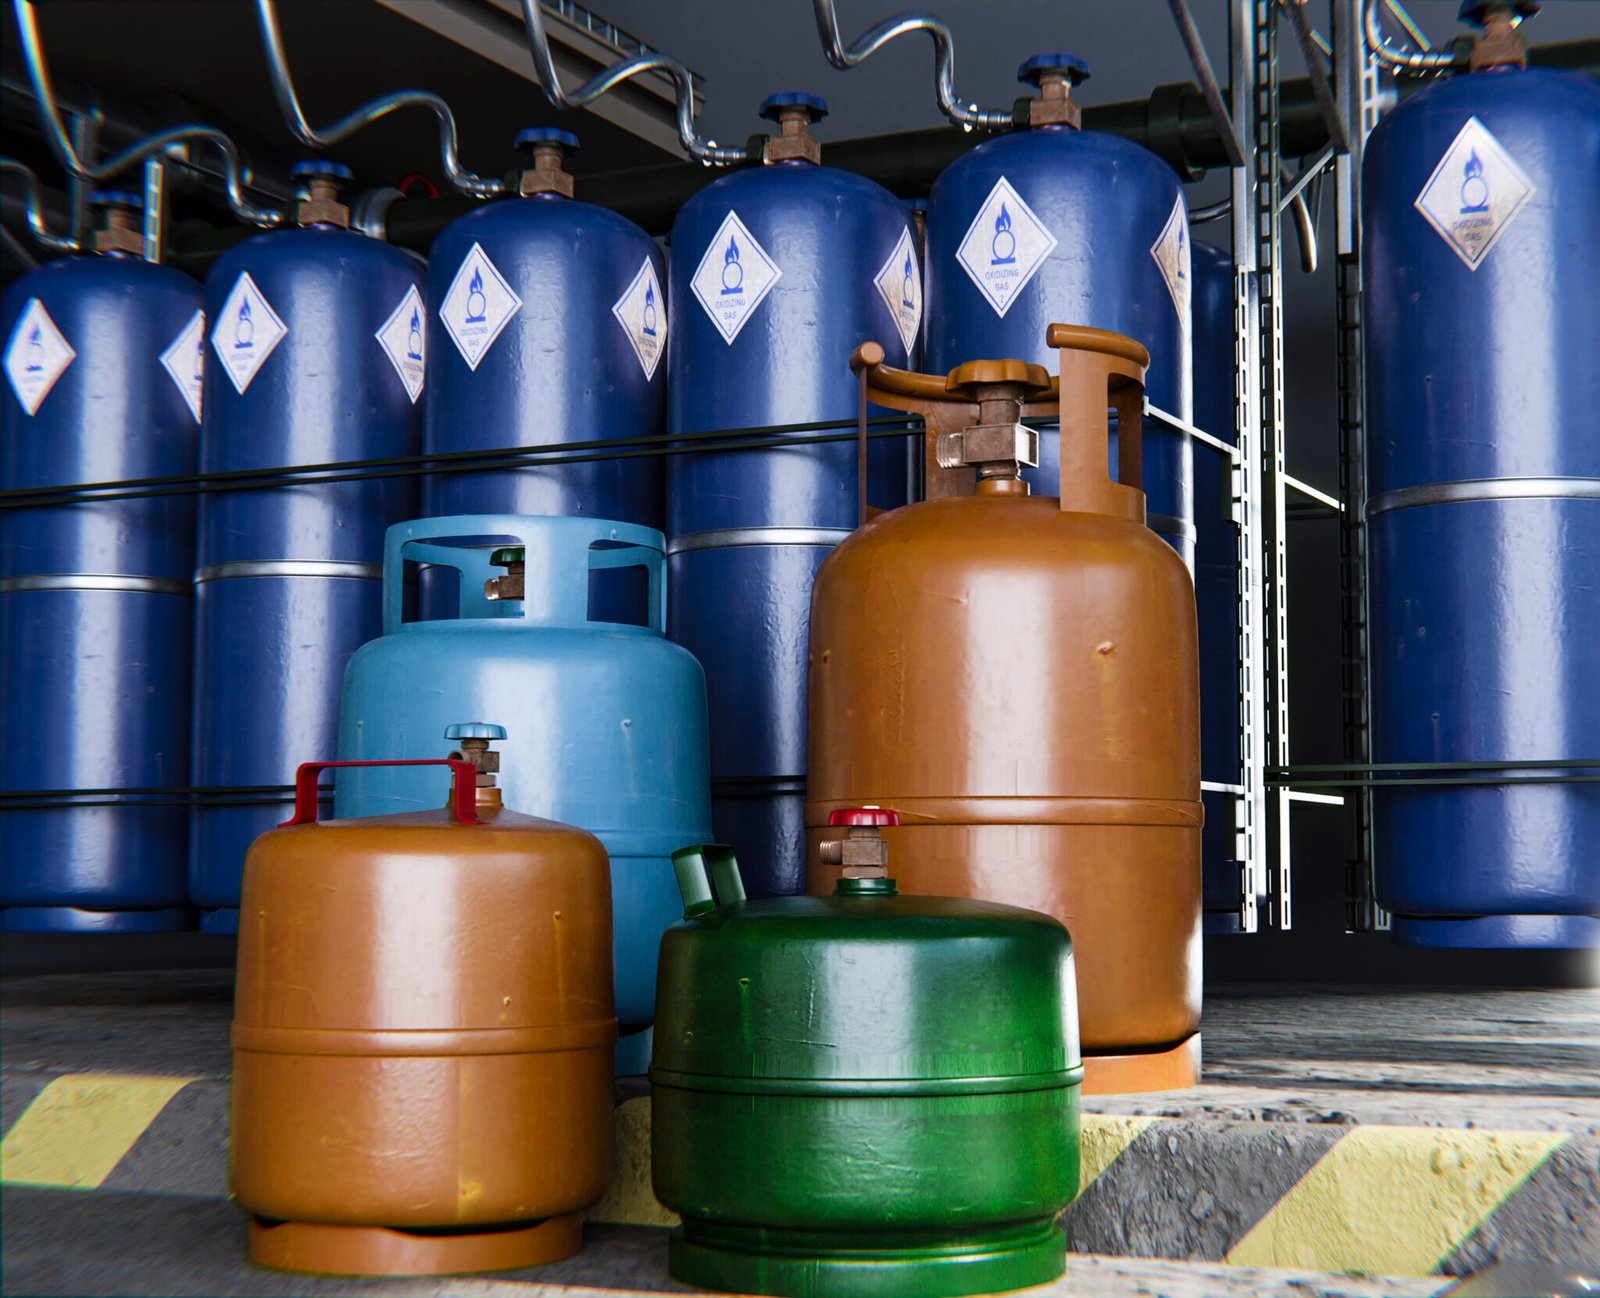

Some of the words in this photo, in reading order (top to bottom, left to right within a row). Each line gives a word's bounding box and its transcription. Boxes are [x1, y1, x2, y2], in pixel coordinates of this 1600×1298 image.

[985, 269, 1020, 281] OXIDIZING
[994, 281, 1010, 292] GAS
[715, 298, 747, 310] OXIDIZING
[724, 311, 738, 321] GAS
